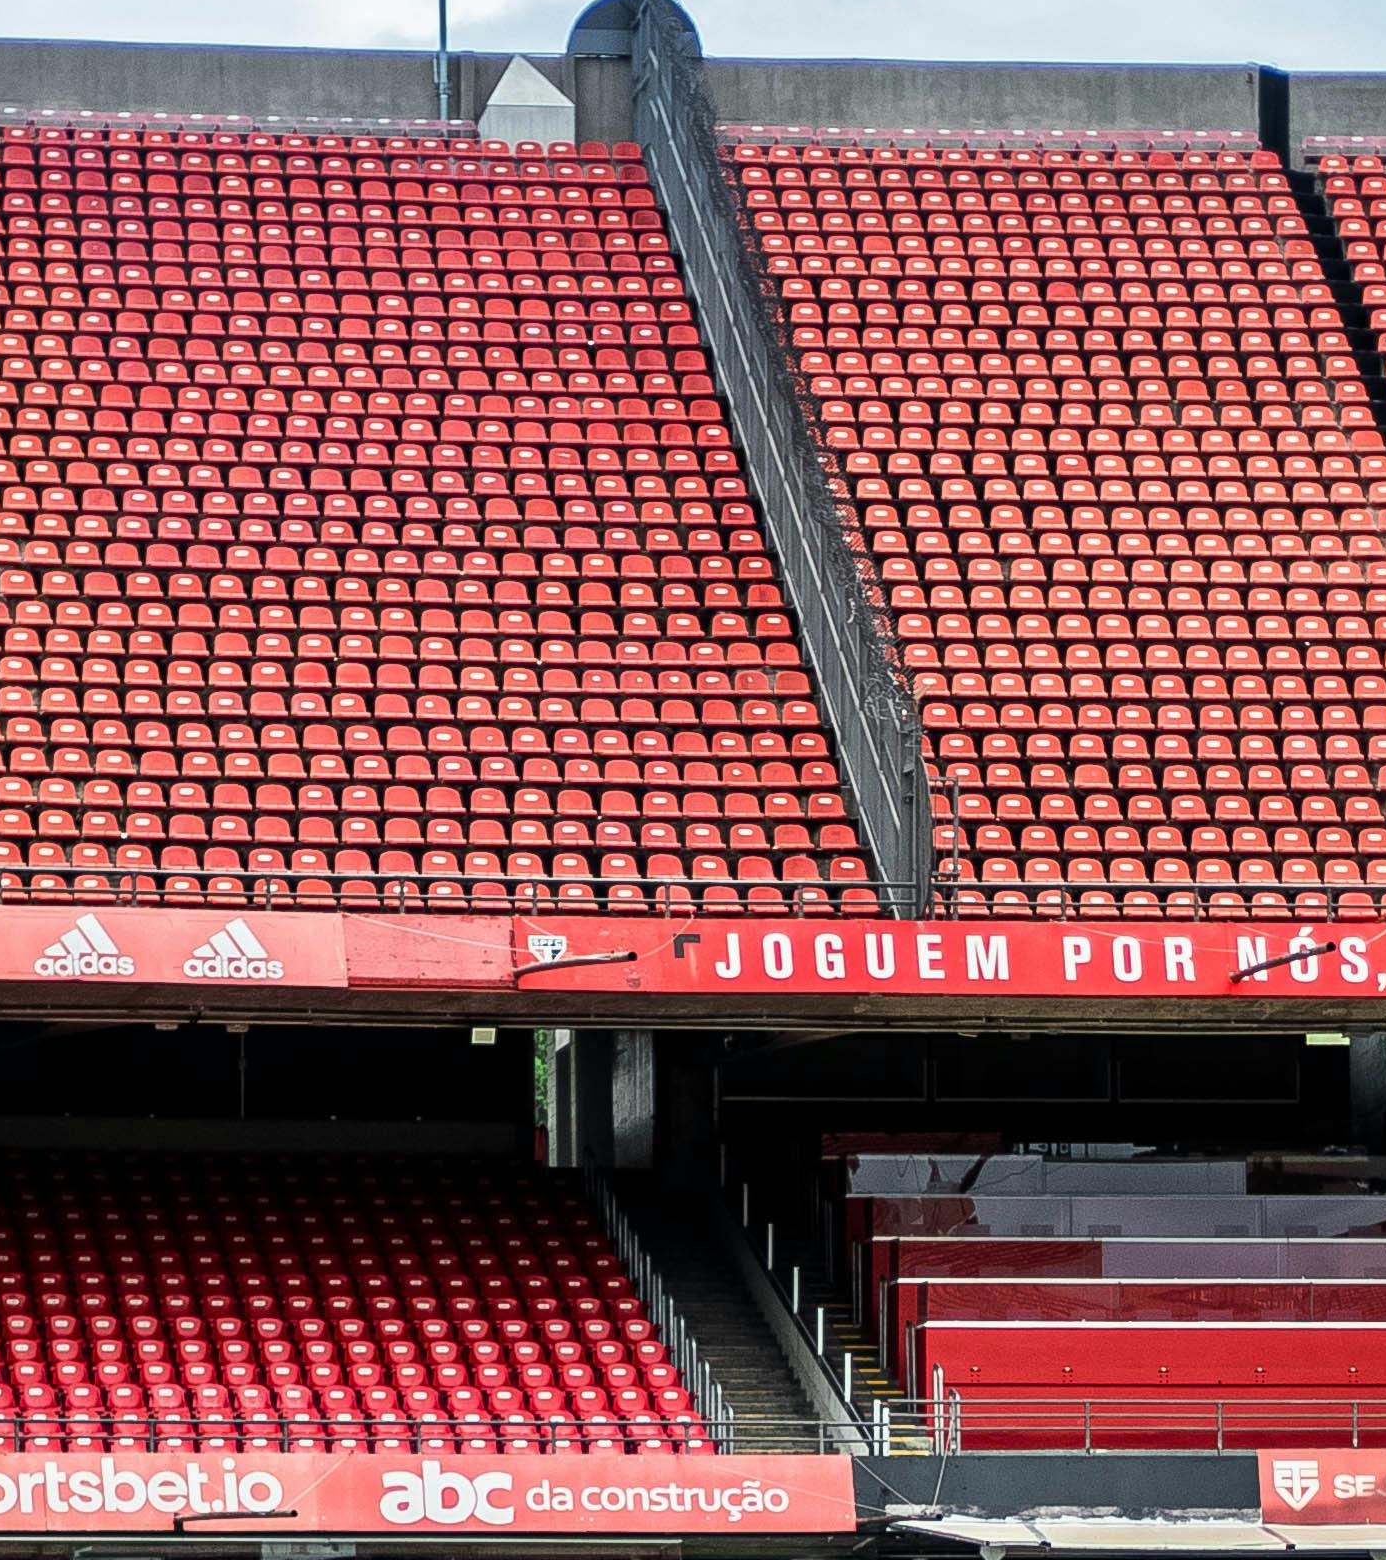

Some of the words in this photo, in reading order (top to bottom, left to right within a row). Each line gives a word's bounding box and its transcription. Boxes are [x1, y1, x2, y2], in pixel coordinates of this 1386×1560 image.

[33, 951, 135, 978] adidas
[182, 955, 285, 980] adidas
[715, 933, 1010, 980] JOGUEM
[1063, 935, 1196, 982] POR
[379, 1460, 515, 1525] abc
[525, 1479, 574, 1512] da
[581, 1480, 791, 1523] construção
